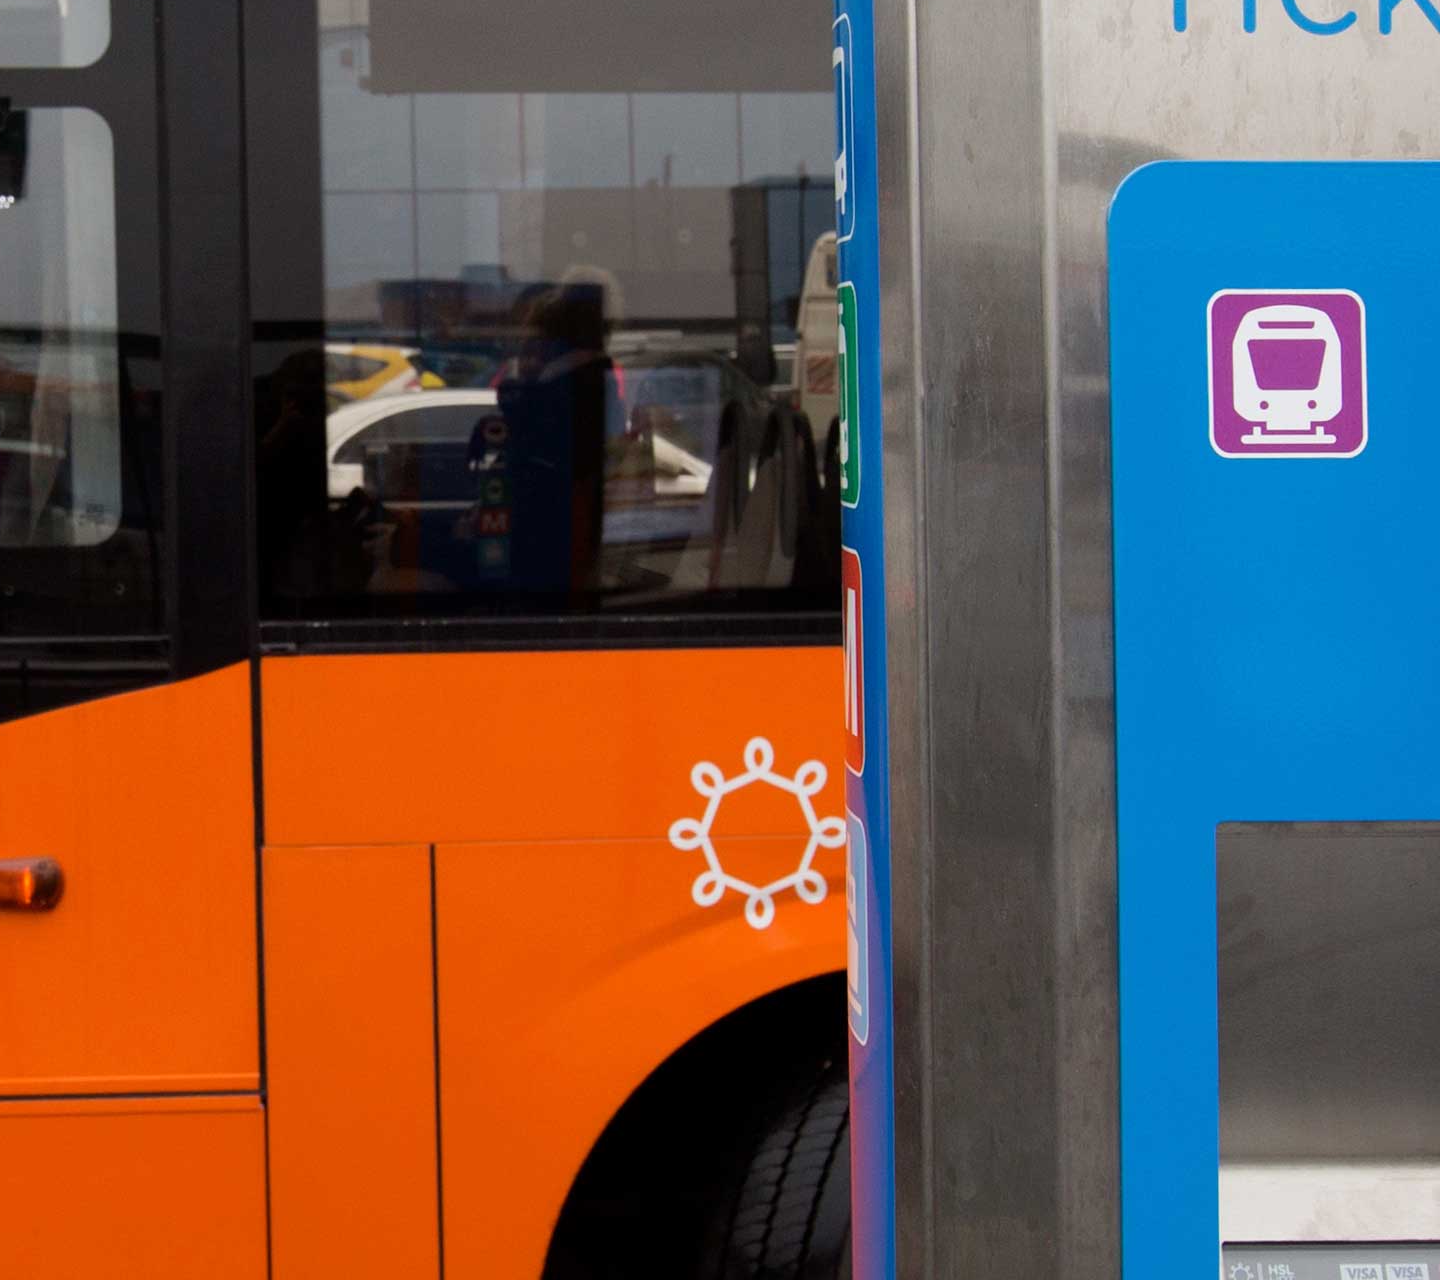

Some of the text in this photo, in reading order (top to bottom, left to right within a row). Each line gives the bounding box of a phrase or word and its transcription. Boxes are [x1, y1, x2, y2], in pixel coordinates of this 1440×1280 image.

[1268, 1264, 1292, 1275] HSL
[1346, 1266, 1424, 1280] VISA VISA
